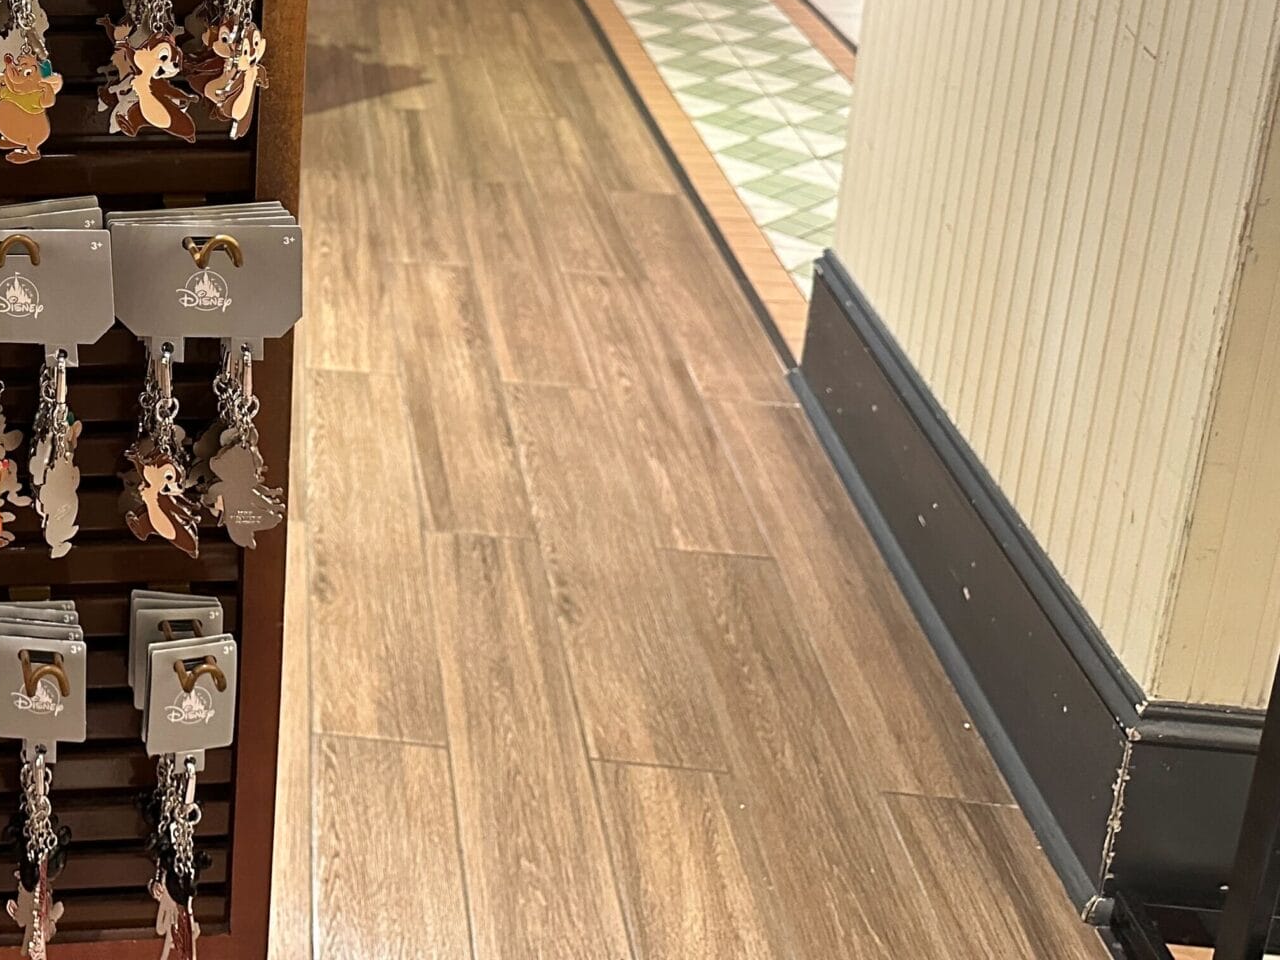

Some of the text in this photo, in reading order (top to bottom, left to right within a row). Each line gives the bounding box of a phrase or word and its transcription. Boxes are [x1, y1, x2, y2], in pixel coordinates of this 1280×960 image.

[84, 219, 96, 229] 3+
[90, 241, 103, 251] 3+
[282, 236, 296, 246] 3+
[176, 288, 233, 313] Disney
[63, 614, 75, 623] 3+
[209, 611, 220, 619] 3+
[68, 632, 80, 641] 3+
[70, 645, 82, 654] 3+
[223, 645, 234, 655] 3+
[10, 691, 64, 717] Disney
[164, 705, 216, 725] Disney
